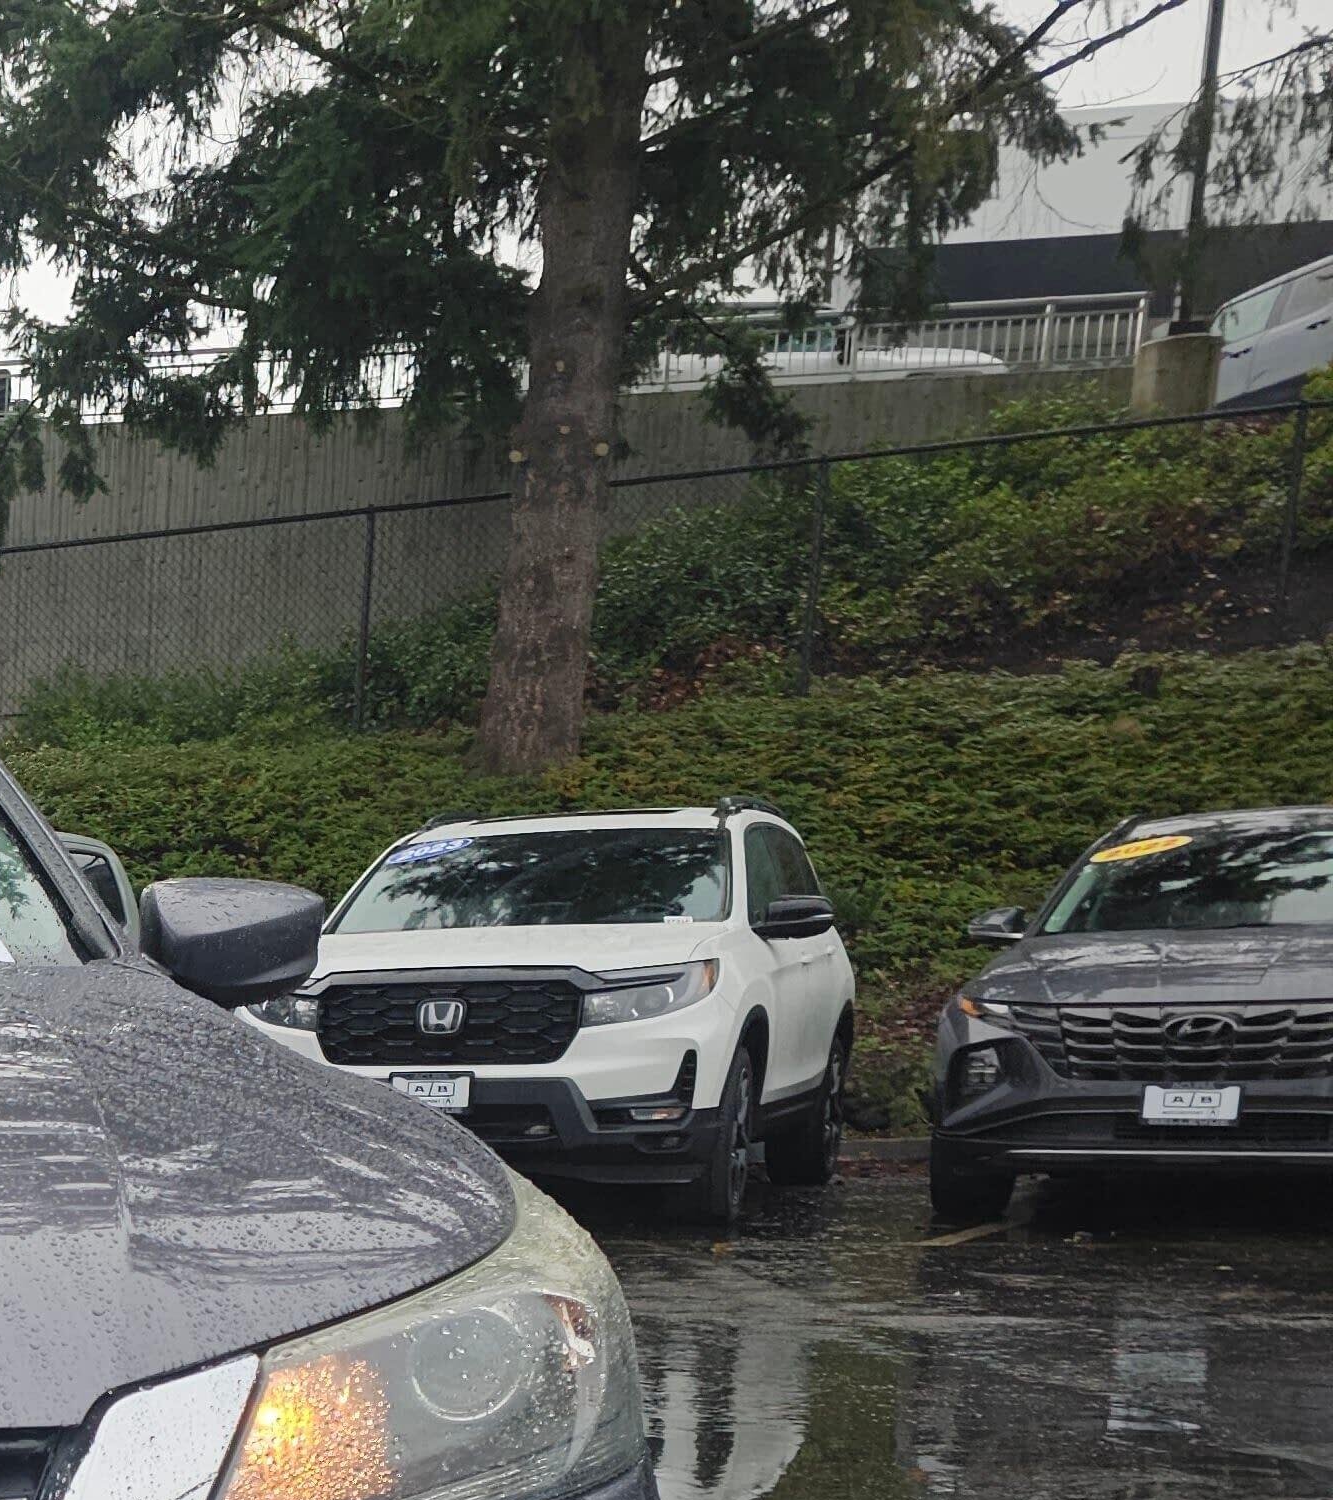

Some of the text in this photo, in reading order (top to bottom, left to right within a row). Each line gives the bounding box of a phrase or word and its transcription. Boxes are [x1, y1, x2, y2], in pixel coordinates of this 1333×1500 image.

[395, 840, 465, 861] 2023
[414, 1085, 448, 1093] A B
